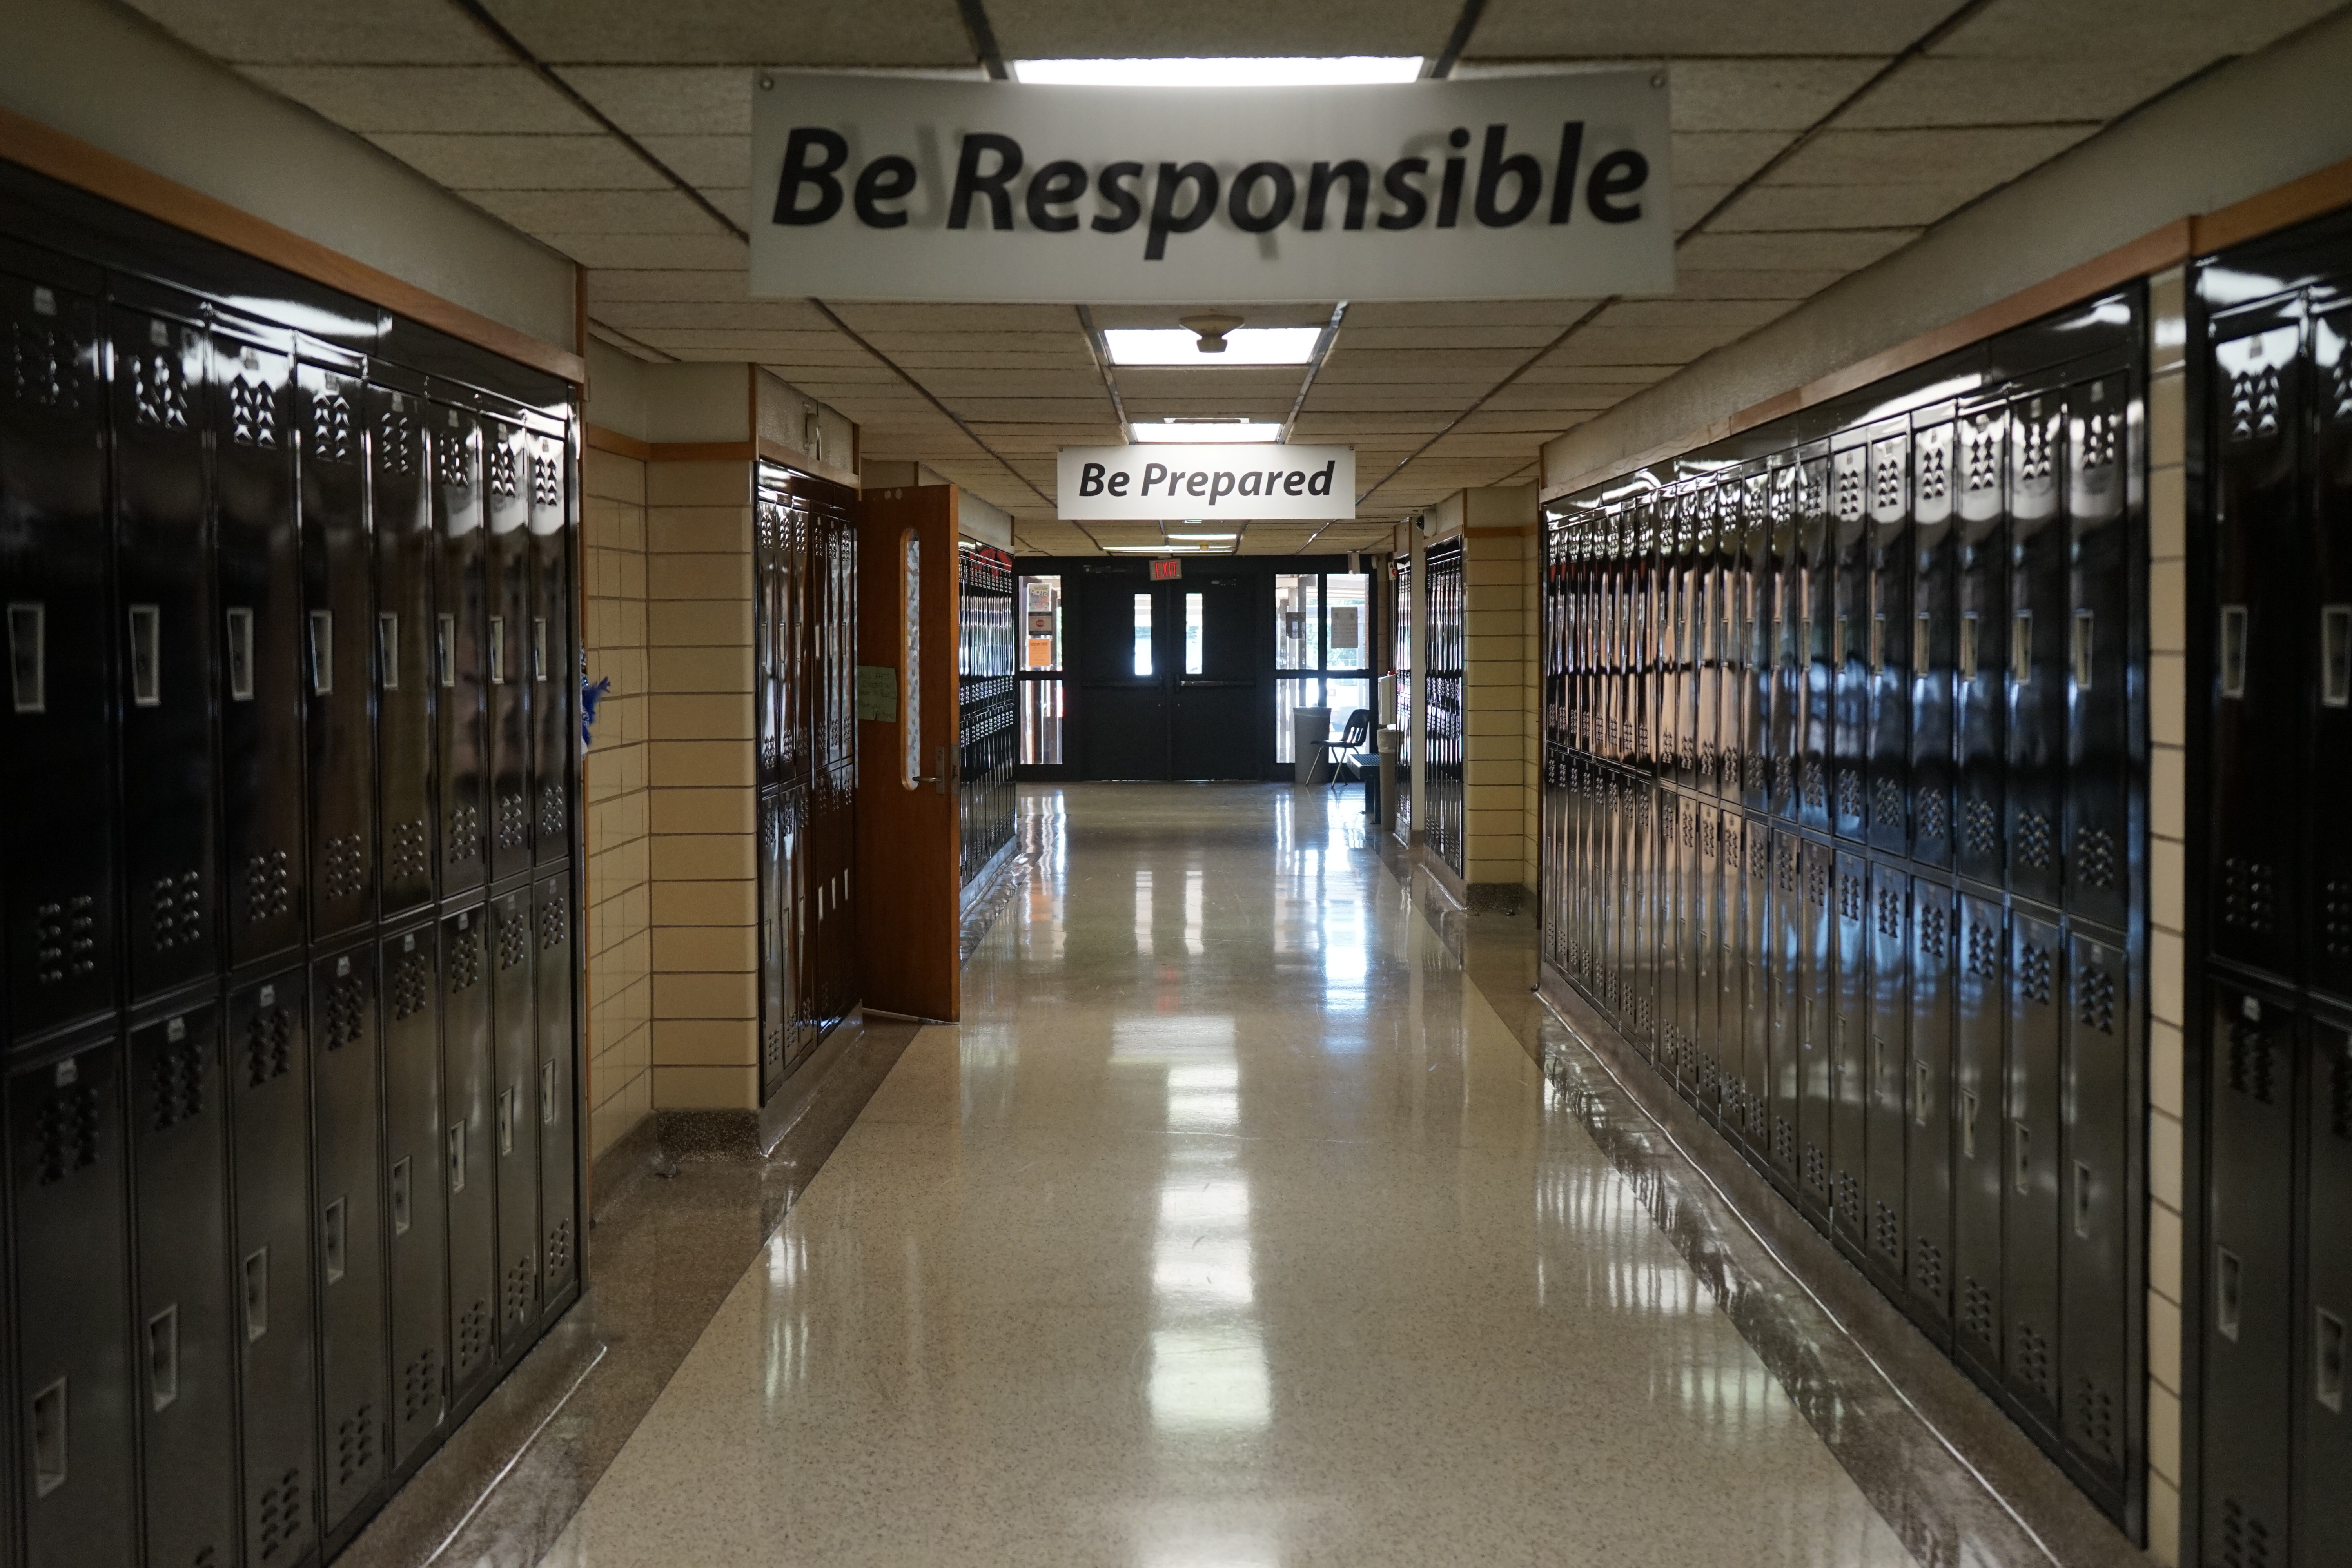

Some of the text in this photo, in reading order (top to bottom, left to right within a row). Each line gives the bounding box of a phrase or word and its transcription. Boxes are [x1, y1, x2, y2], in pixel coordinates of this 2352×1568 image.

[772, 121, 1650, 260] Be Responsible
[1079, 460, 1336, 506] Be Prepared
[1155, 561, 1177, 578] EXIT
